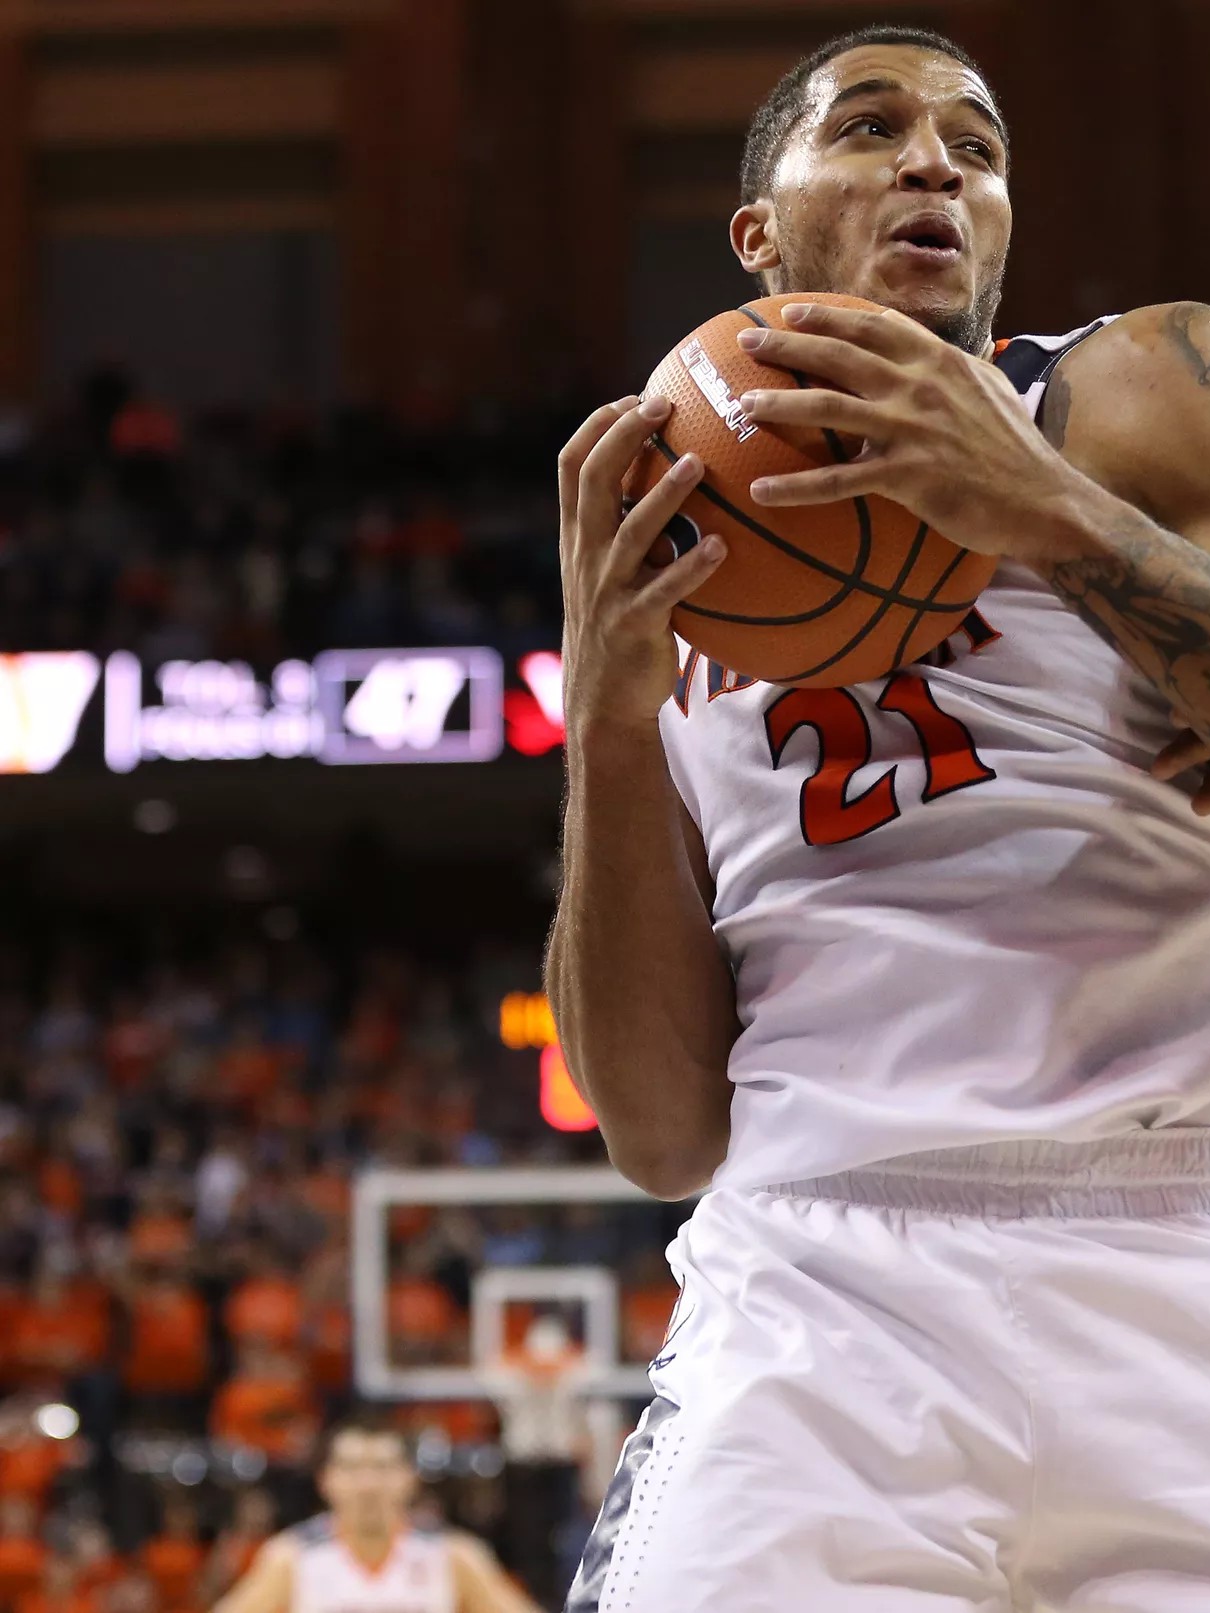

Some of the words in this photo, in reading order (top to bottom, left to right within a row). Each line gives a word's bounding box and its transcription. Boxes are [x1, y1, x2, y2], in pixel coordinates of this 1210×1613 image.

[678, 338, 759, 443] HYPERELITE
[344, 657, 463, 750] 47
[764, 671, 997, 846] 21
